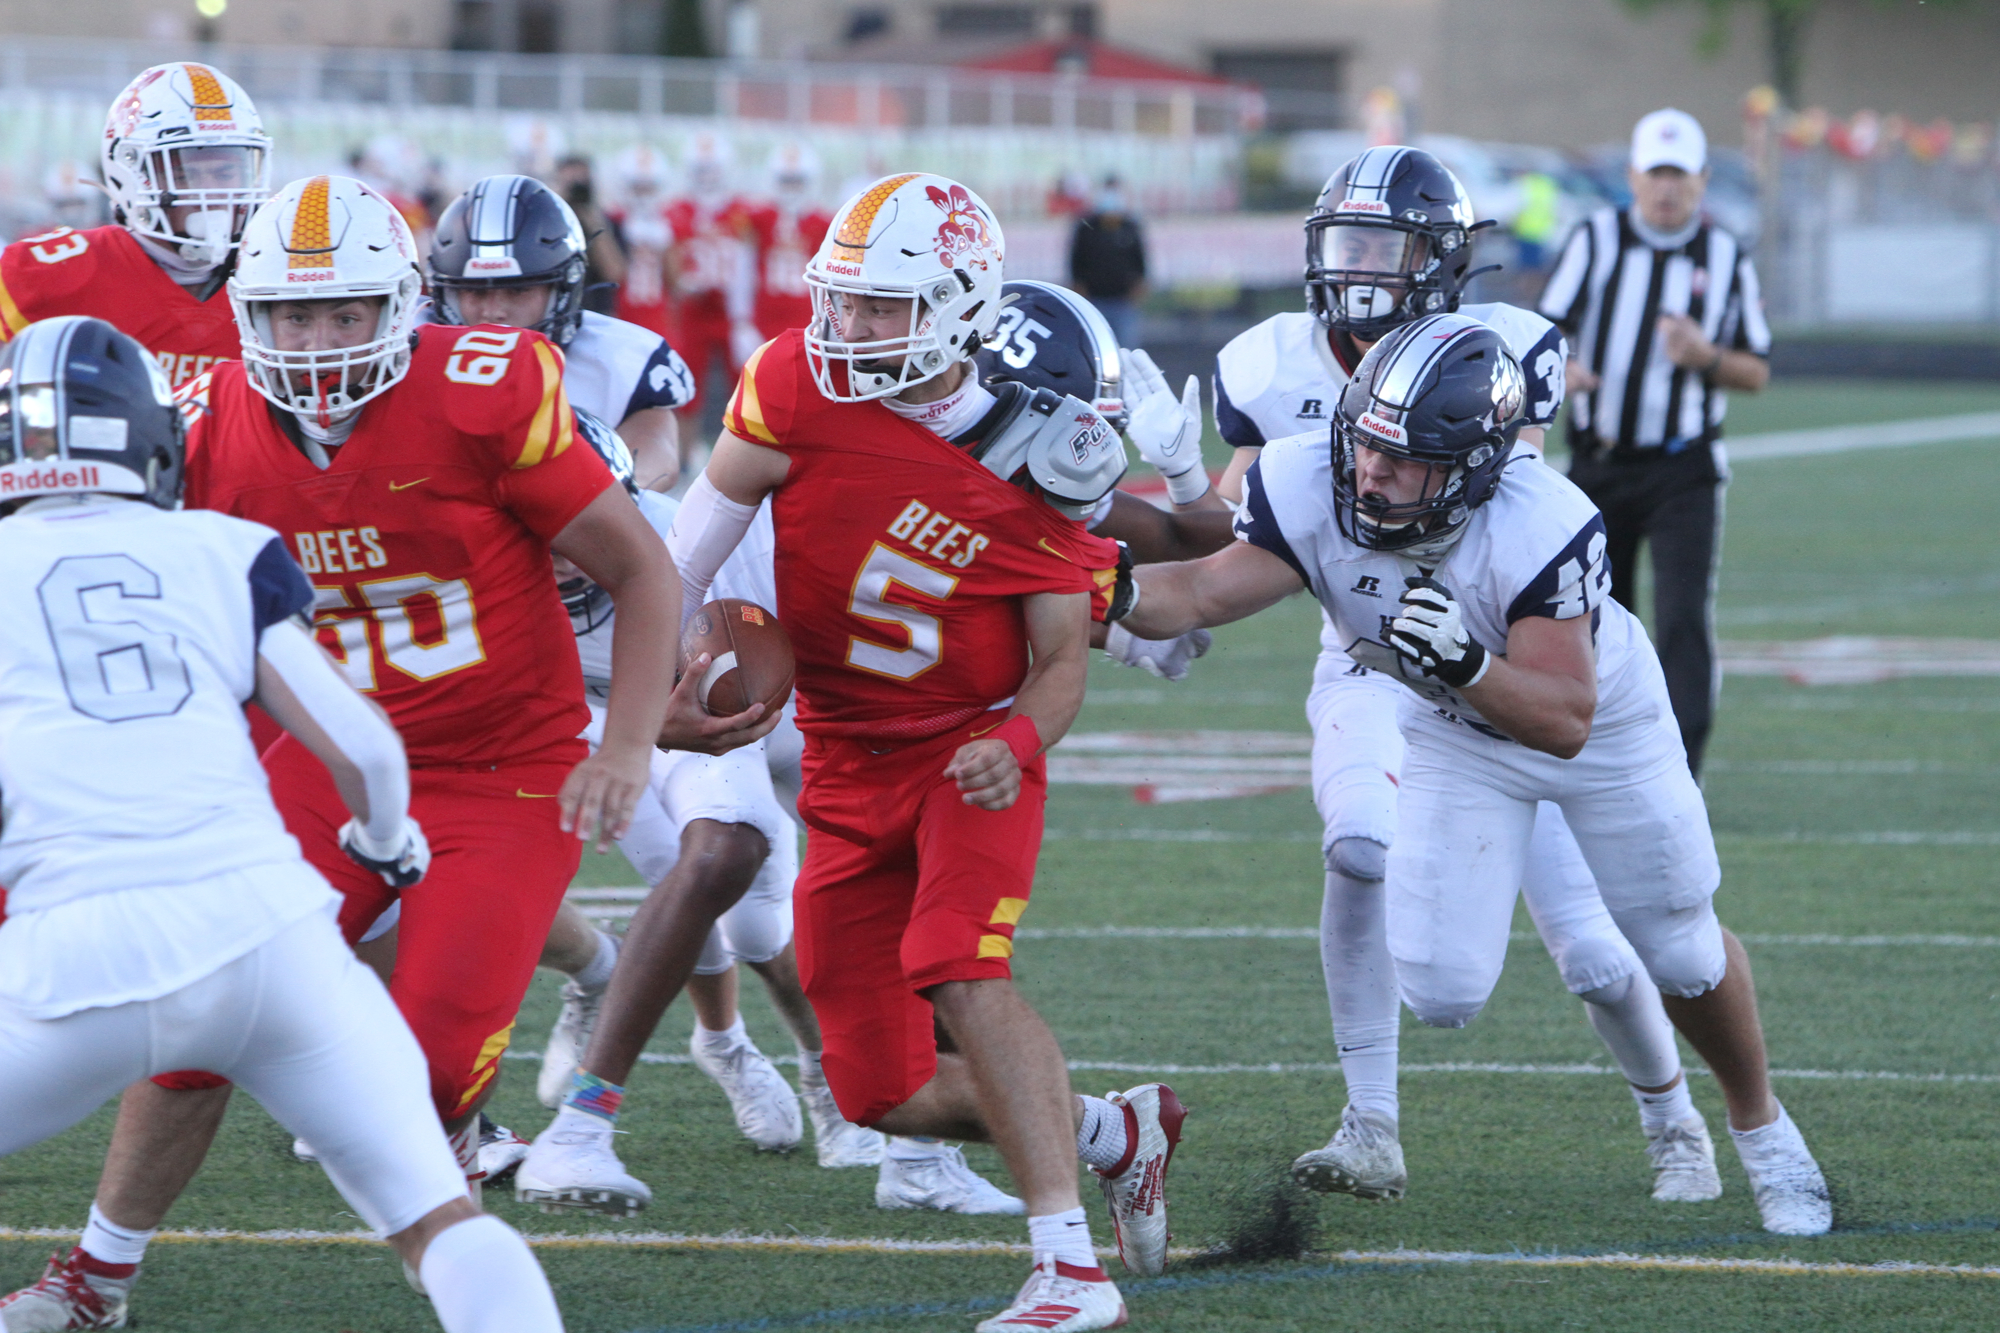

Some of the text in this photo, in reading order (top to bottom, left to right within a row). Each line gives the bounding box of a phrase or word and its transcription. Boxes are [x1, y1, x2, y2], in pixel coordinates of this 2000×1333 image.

[1343, 202, 1384, 212] Riddell
[287, 271, 335, 282] Riddell
[471, 259, 512, 269] Riddell
[826, 261, 861, 277] Riddell
[982, 306, 1053, 369] 35
[444, 331, 522, 386] 60
[1362, 416, 1400, 439] Riddell
[0, 466, 99, 493] Riddell
[295, 525, 388, 574] BEES
[886, 498, 990, 569] BEES
[1350, 587, 1383, 598] RUSSELL
[1544, 531, 1612, 619] 42
[844, 540, 960, 682] 5
[36, 553, 194, 723] 6
